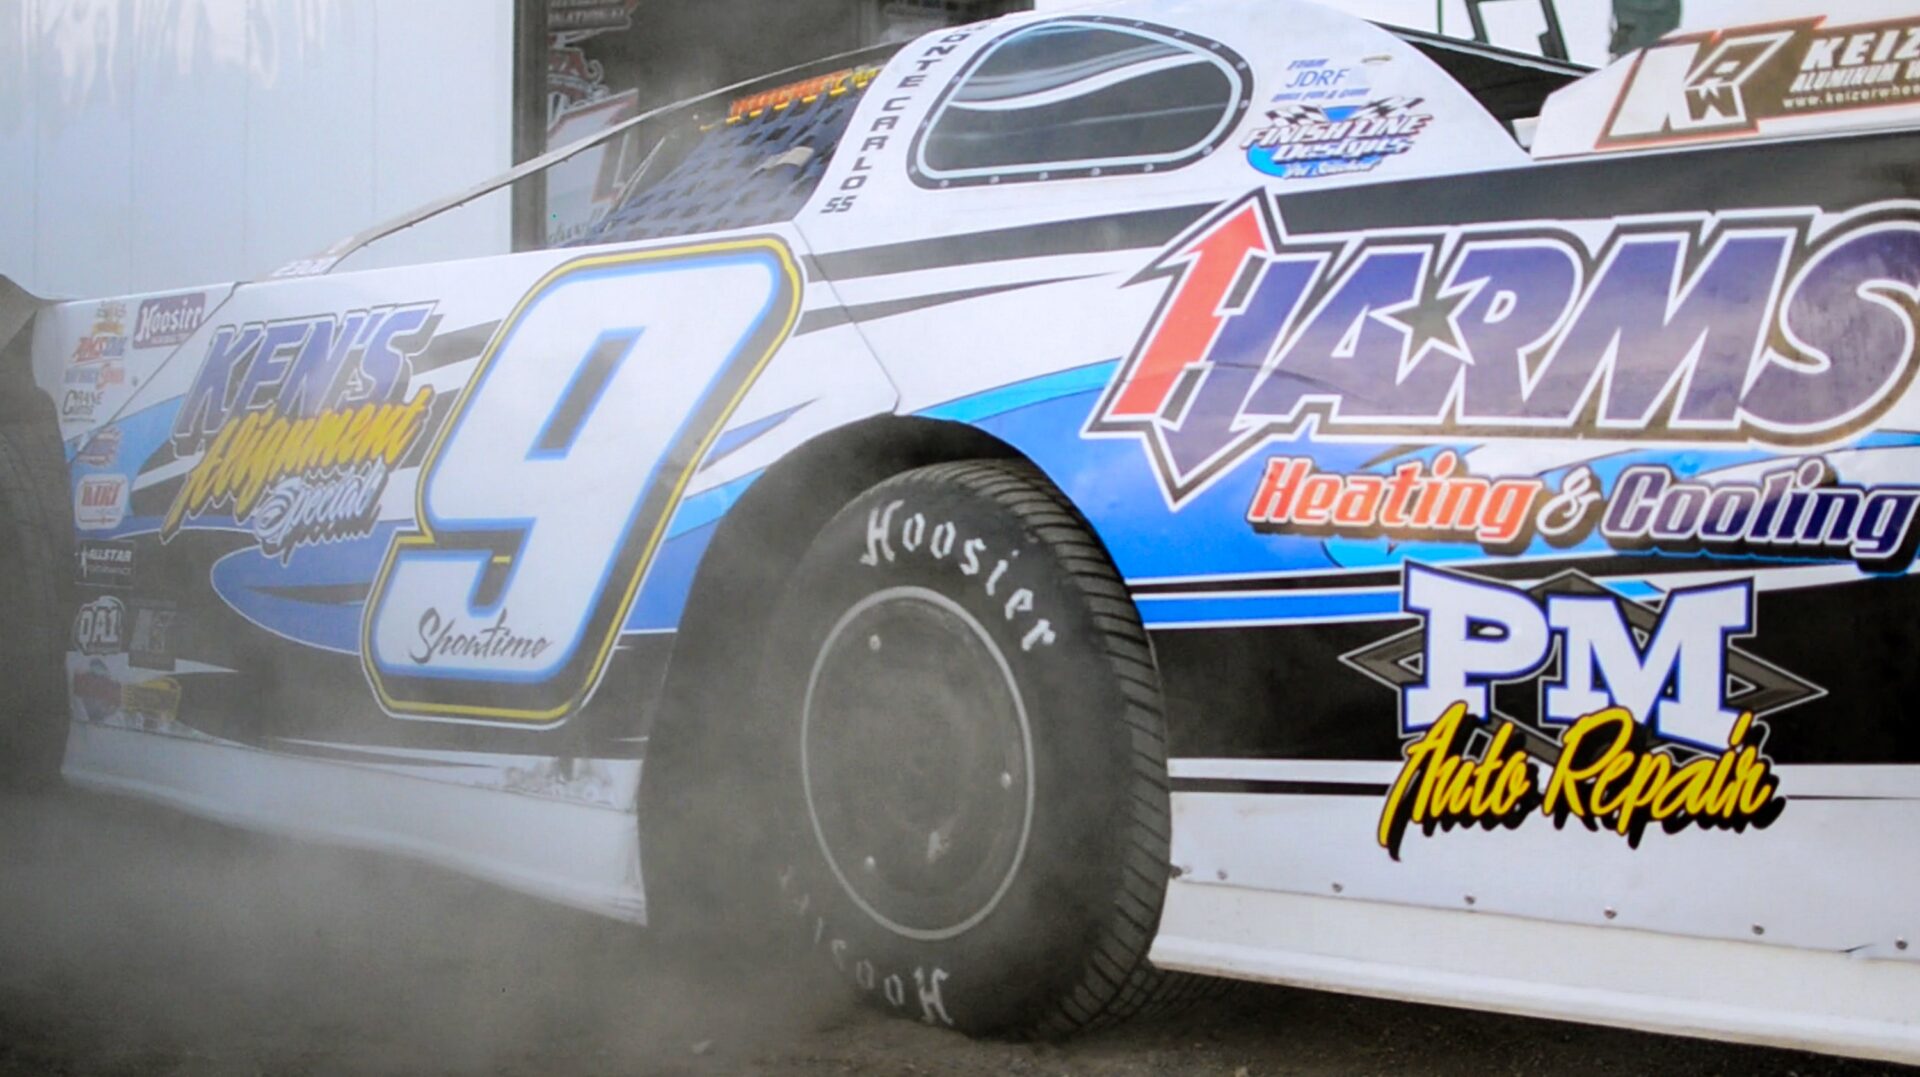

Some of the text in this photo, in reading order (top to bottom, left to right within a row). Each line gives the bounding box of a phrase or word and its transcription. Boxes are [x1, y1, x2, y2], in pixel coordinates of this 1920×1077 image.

[897, 25, 986, 89] ONTE
[1285, 68, 1351, 89] JDRF
[1789, 62, 1899, 93] ALUMINUM
[1241, 114, 1434, 150] FINISH LINE
[174, 300, 440, 452] KEN'S
[1083, 192, 1920, 508] HARMS
[254, 456, 388, 550] Special
[362, 236, 801, 728] 9
[1248, 451, 1920, 557] Heating & Cooling
[78, 606, 121, 651] QA1
[409, 606, 553, 664] Showtime
[1400, 560, 1756, 752] PM
[1378, 700, 1773, 848] Auto Repair
